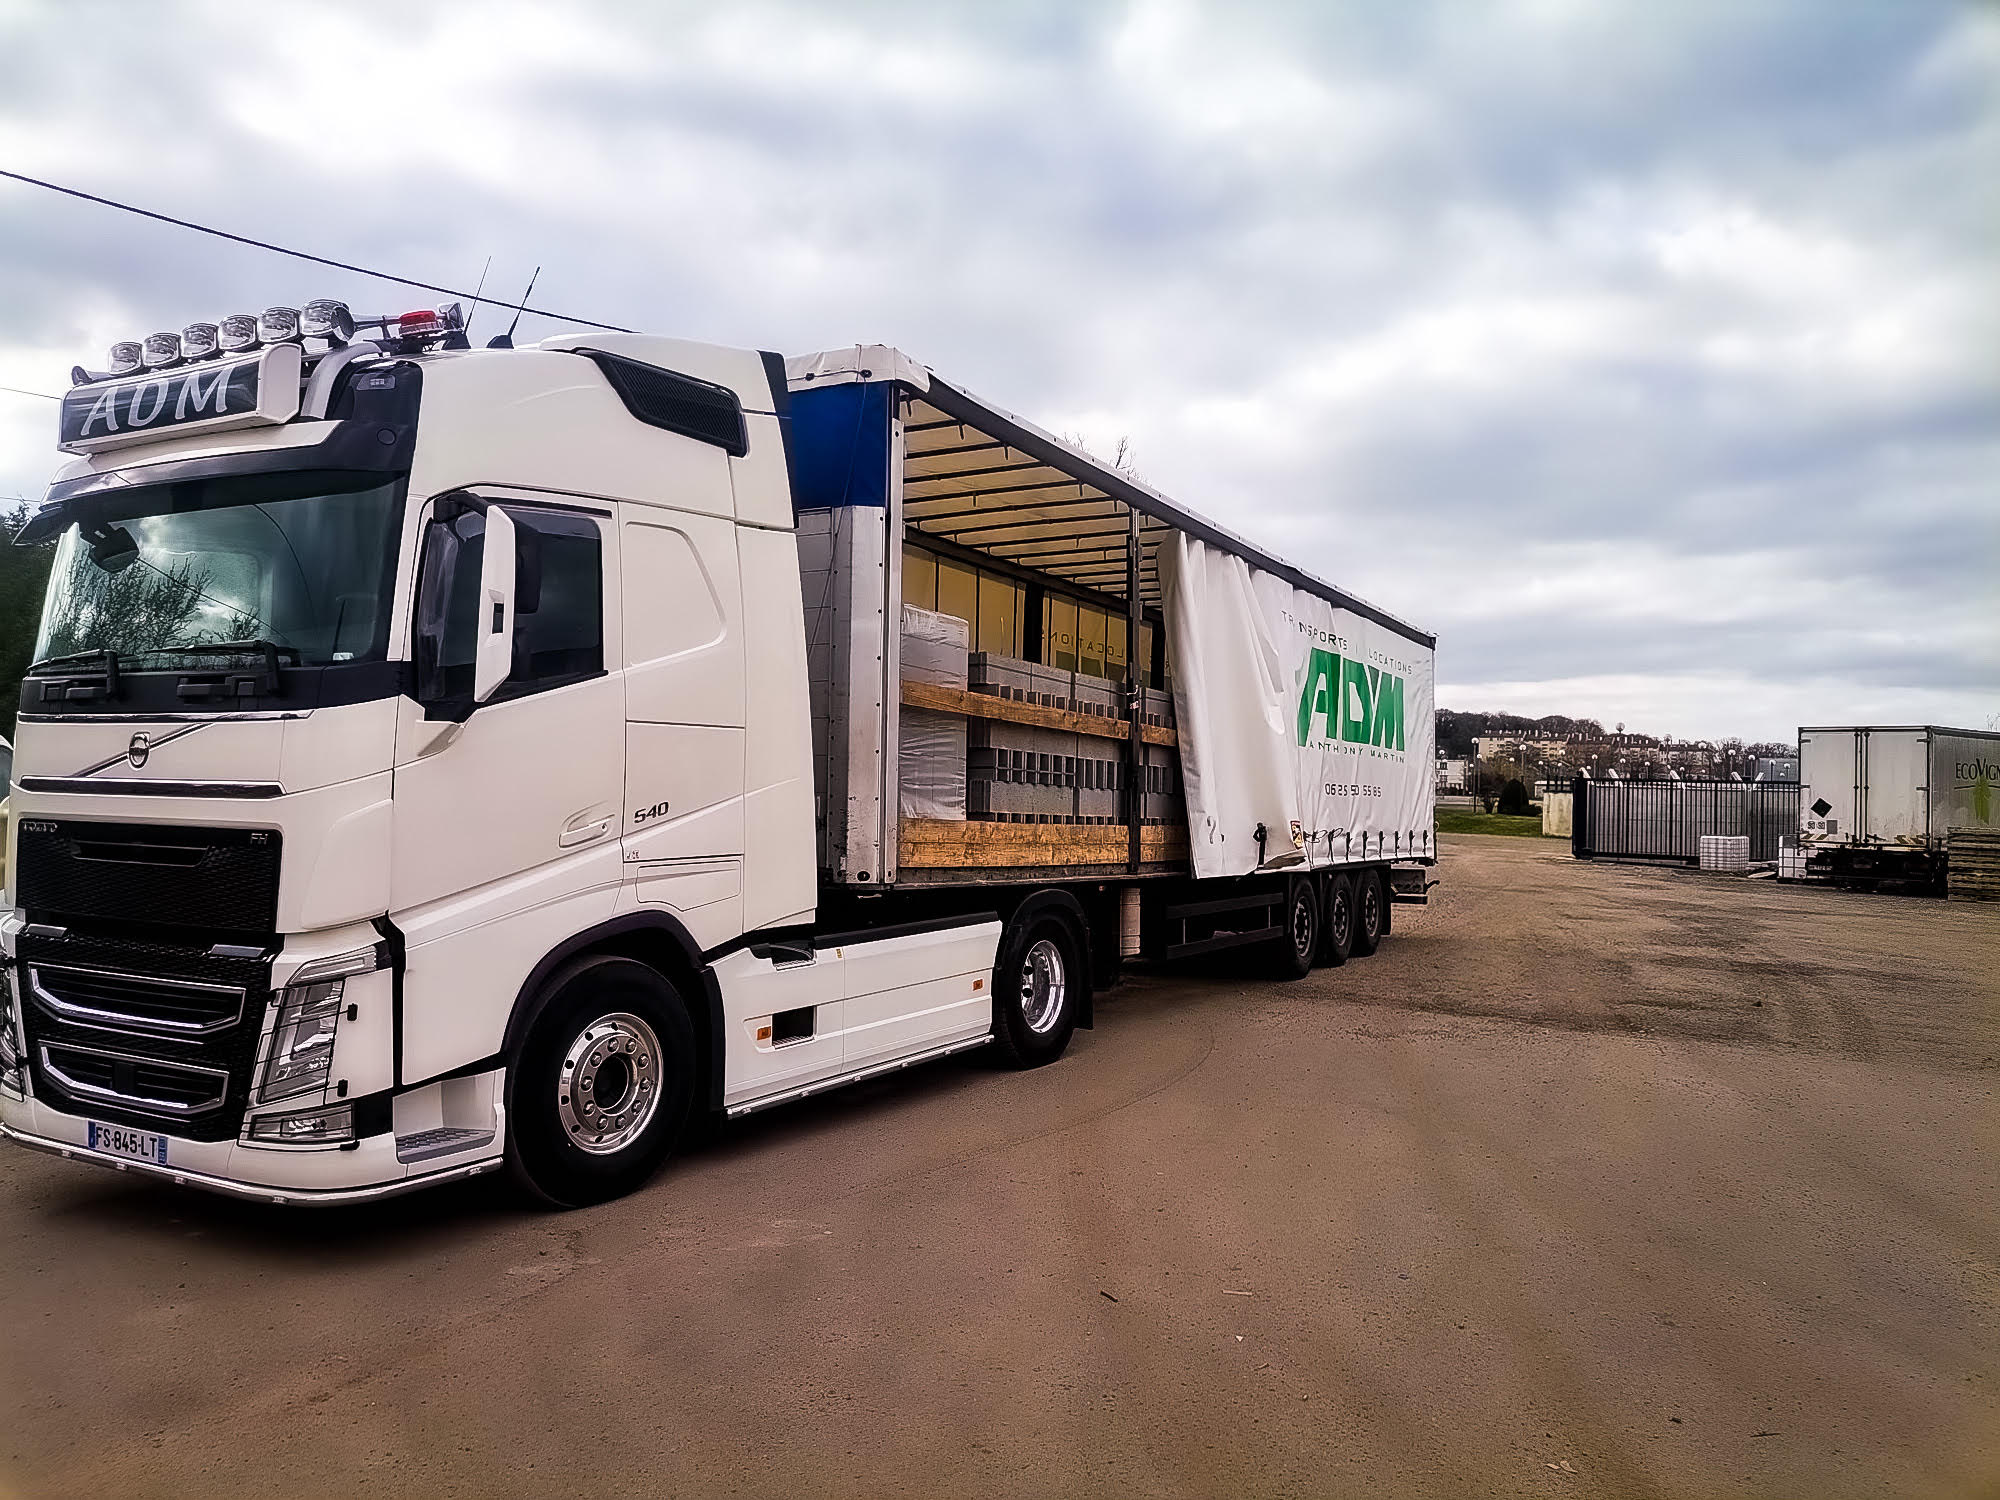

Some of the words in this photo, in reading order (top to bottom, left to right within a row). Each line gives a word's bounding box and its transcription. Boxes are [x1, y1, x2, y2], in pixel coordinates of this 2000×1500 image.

[1282, 610, 1347, 650] TRNSPORTS
[1368, 647, 1412, 675] LOCATIONS
[1297, 647, 1405, 752] ADM
[1370, 749, 1405, 763] MARTIN
[633, 801, 669, 824] 540
[95, 1126, 158, 1158] FS-845-LT
